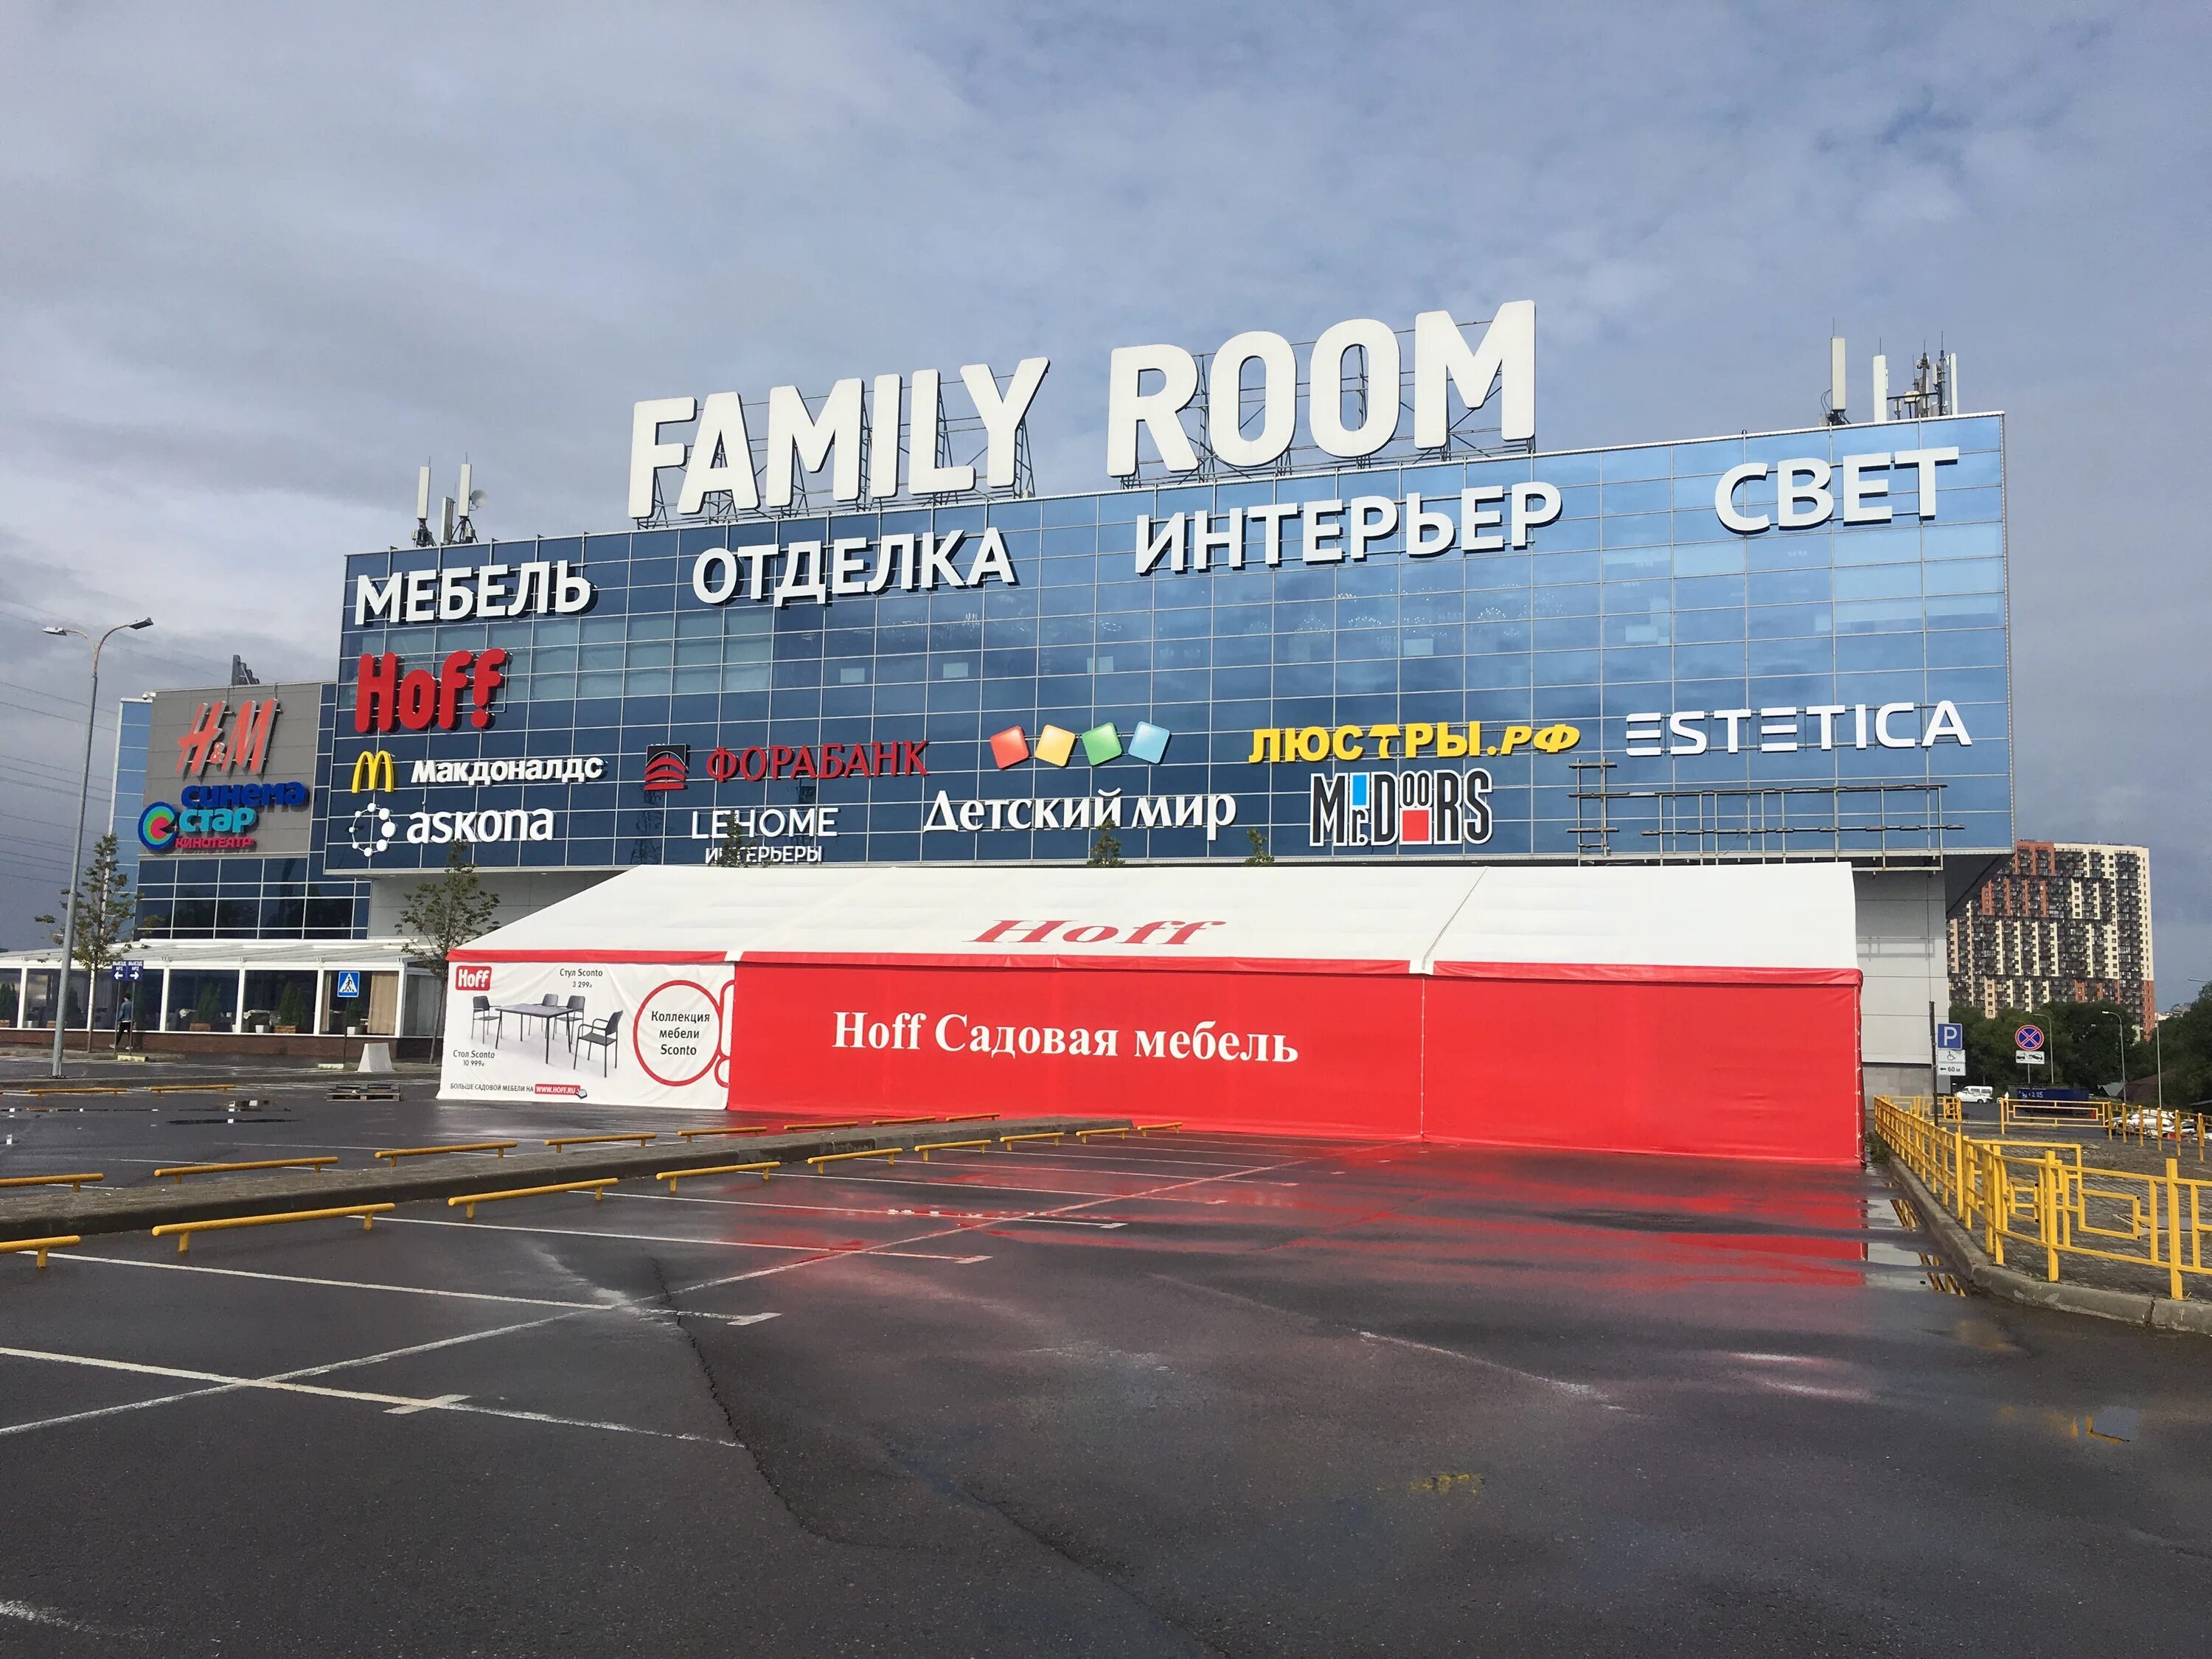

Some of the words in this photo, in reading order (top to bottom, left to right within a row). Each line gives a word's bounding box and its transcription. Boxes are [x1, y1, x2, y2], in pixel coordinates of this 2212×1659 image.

[628, 356, 1051, 519] FAMILY
[1107, 299, 1536, 479] ROOM
[1715, 447, 1959, 532] СВЕТ
[1135, 481, 1562, 574] ИНТЕРЬЕР
[692, 527, 1015, 606] ОТДЕЛКА
[355, 559, 593, 626] МЕБЕЛЬ
[176, 698, 278, 776] H&M
[1248, 720, 1580, 764] ЛЮСТРЫ.РФ
[1626, 700, 1972, 757] ESTETICA
[706, 740, 930, 783] ФОРАБАНК
[406, 808, 554, 844] askona
[923, 787, 1121, 832] Детский
[1131, 794, 1237, 841] мир
[175, 836, 254, 849] КИНОТЕАТР
[705, 845, 822, 864] ИТЕРЬЕРЫ
[961, 919, 1226, 945] Hoff
[560, 968, 576, 978] Стул
[577, 968, 603, 977] Sconto
[651, 1010, 710, 1024] Коллекция
[658, 1026, 700, 1039] мебели
[1944, 1026, 1958, 1046] P
[453, 1049, 470, 1058] Стол
[470, 1050, 495, 1059] Sconto
[660, 1043, 697, 1056] Sconto
[832, 1012, 927, 1050] Hoff
[936, 1013, 1119, 1059] Садовая
[1133, 1020, 1298, 1062] мебель
[474, 1083, 501, 1091] САДОВОЙ
[536, 1086, 576, 1094] WWW.HOFF.RU
